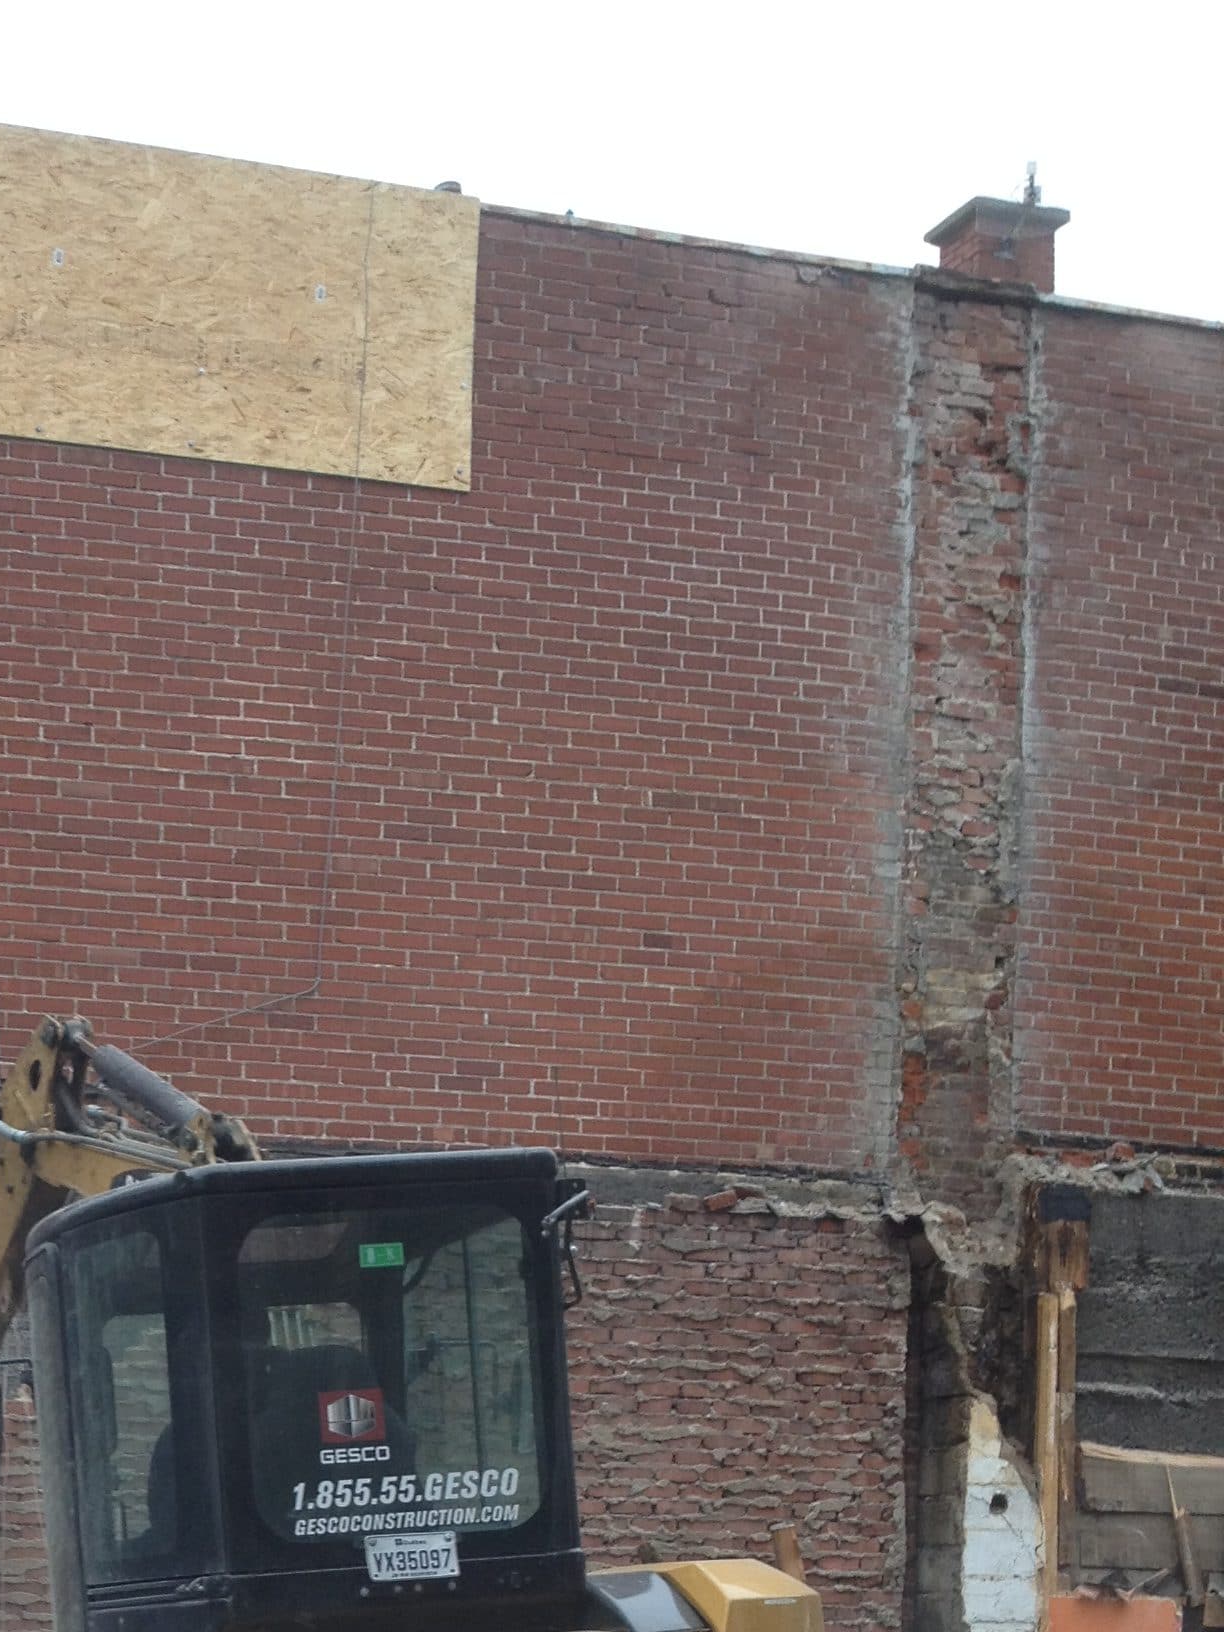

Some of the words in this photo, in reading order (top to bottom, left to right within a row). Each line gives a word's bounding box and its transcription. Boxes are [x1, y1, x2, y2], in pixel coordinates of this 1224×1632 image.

[320, 1446, 390, 1464] GESCO
[293, 1468, 519, 1511] 1.855.55.GESCO
[294, 1504, 520, 1535] GESCOCONSTRUCTION.COM
